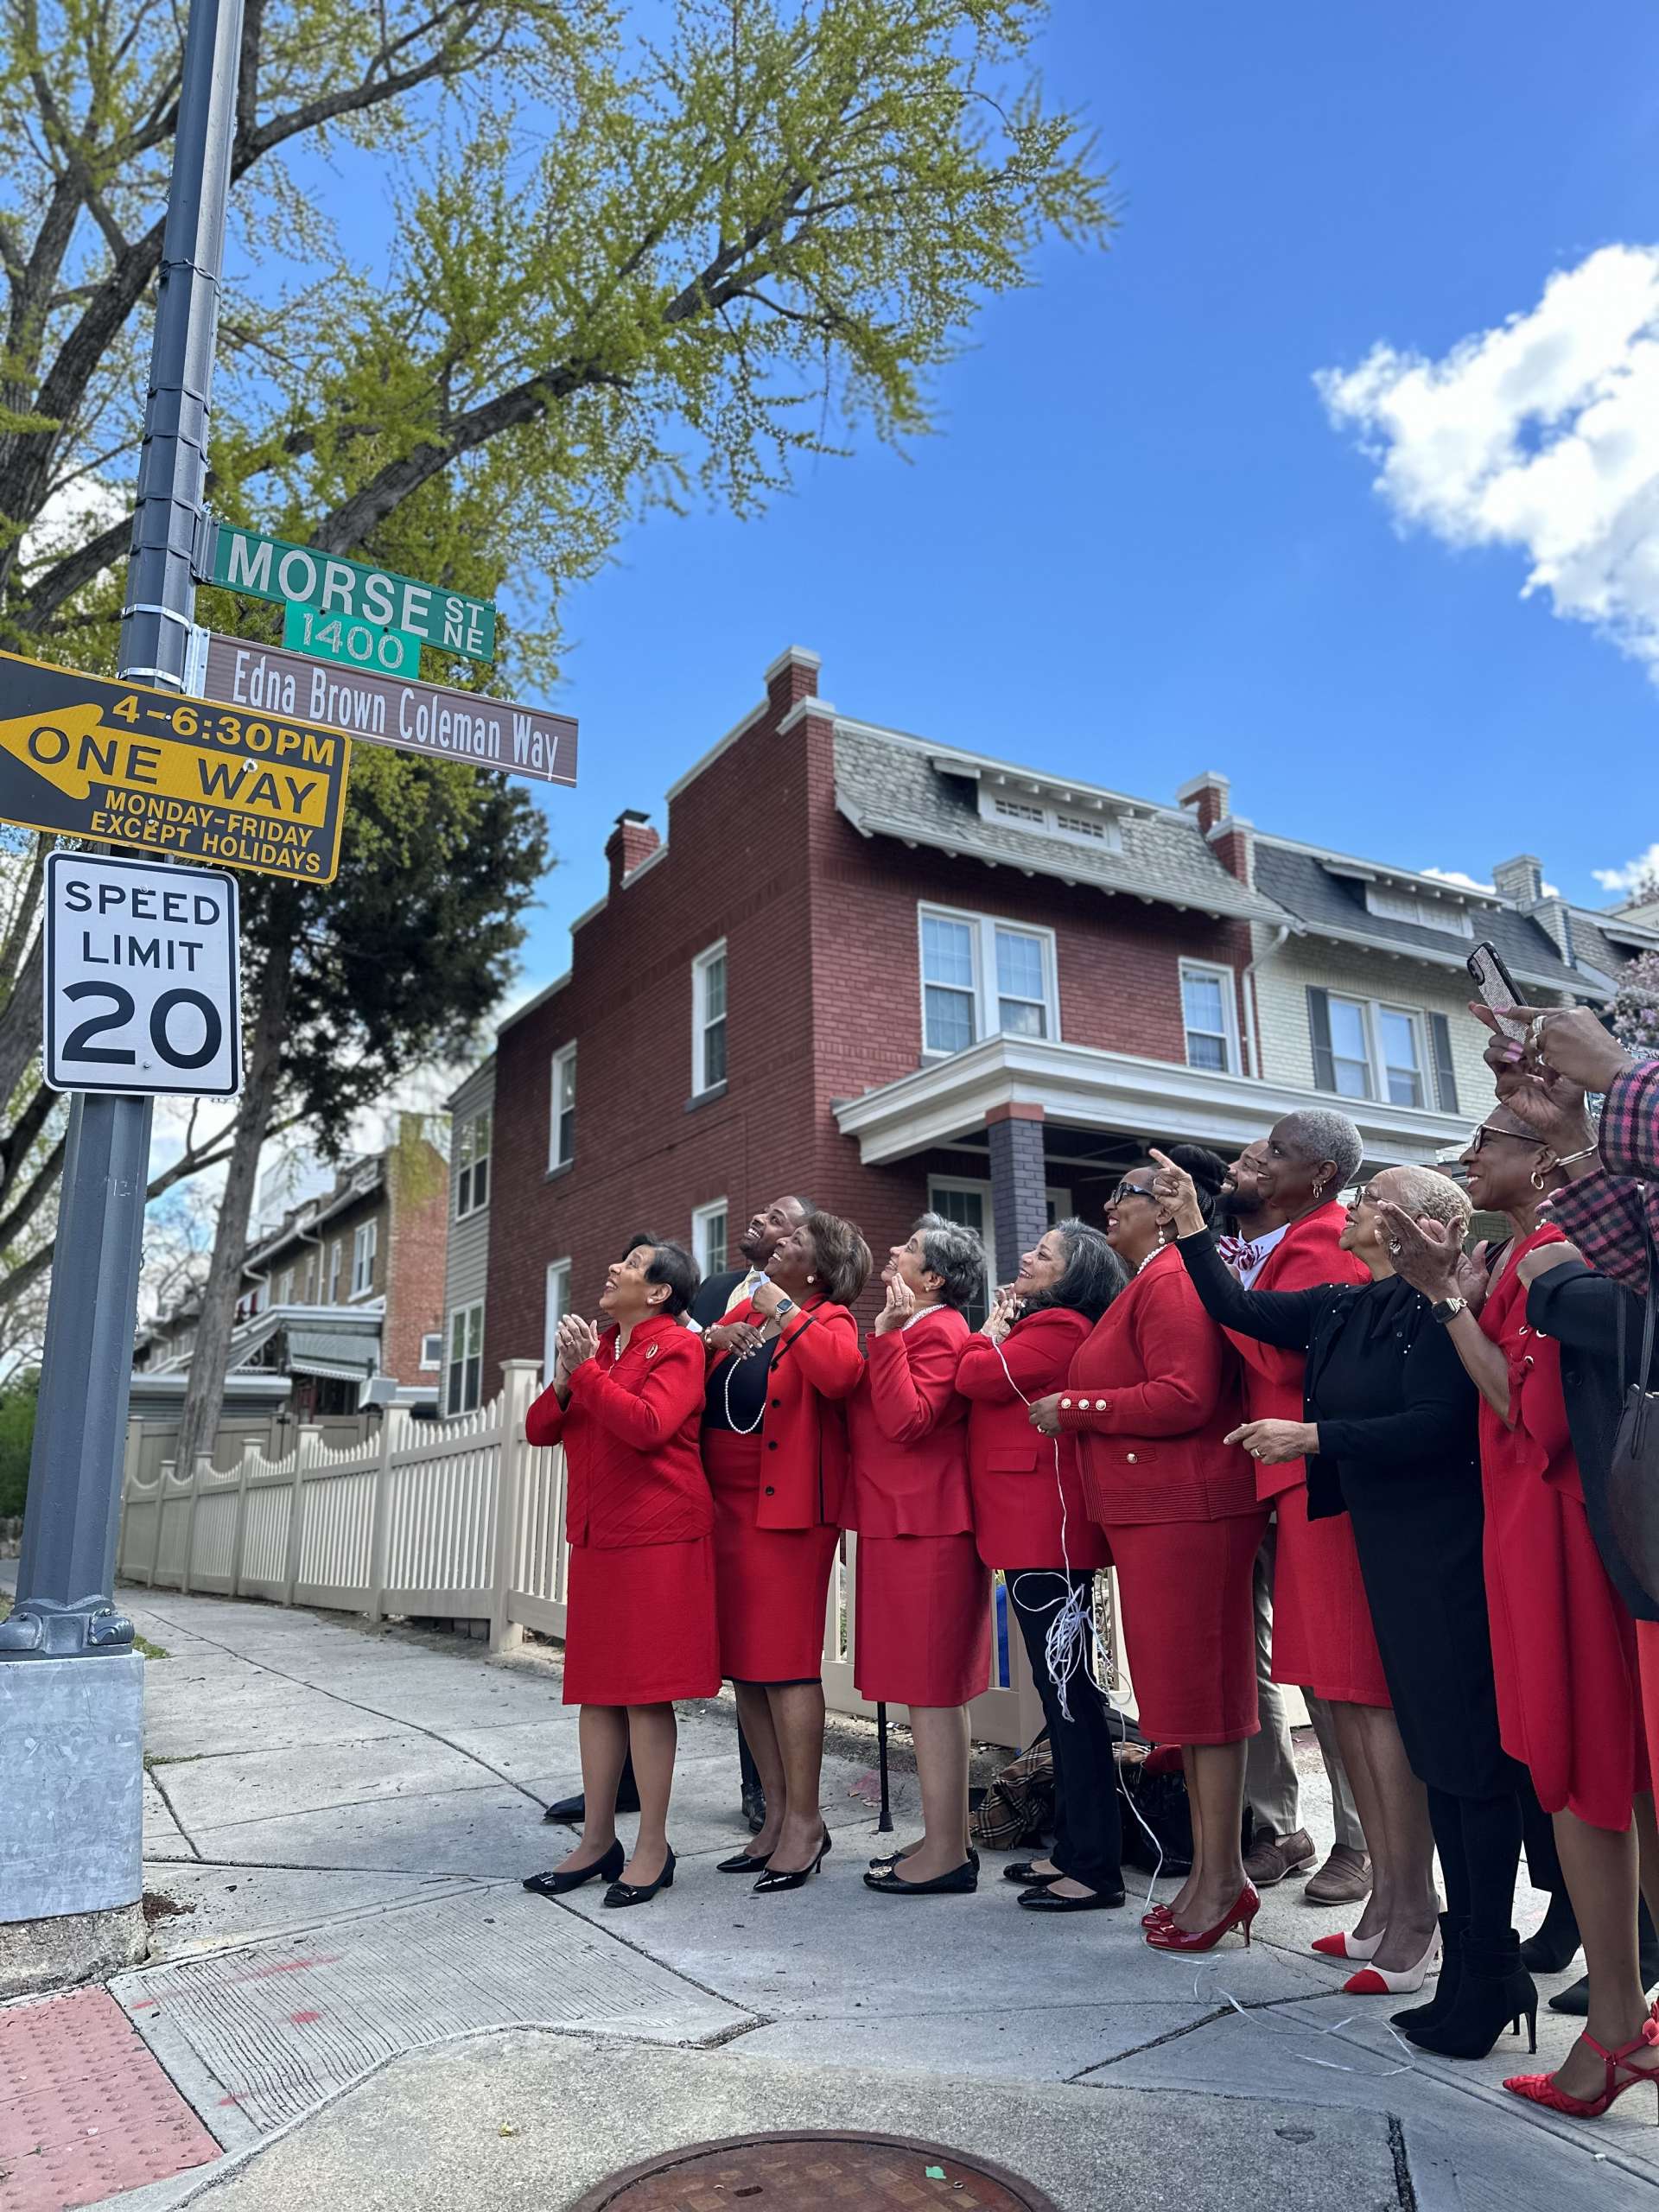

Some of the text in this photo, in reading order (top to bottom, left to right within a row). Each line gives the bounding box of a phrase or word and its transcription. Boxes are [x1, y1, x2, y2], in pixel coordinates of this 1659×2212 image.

[227, 533, 485, 638] MORSE ST
[302, 613, 404, 670] 1400
[444, 624, 484, 655] NE
[232, 651, 558, 781] Edna Brown Coleman Way
[28, 726, 317, 814] ONE WAY
[91, 811, 321, 874] EXCEPT HOLIDAYS
[105, 790, 313, 848] MONDAY-FRIDAY
[64, 880, 220, 925] SPEED
[83, 931, 203, 972] LIMIT
[61, 980, 222, 1070] 20
